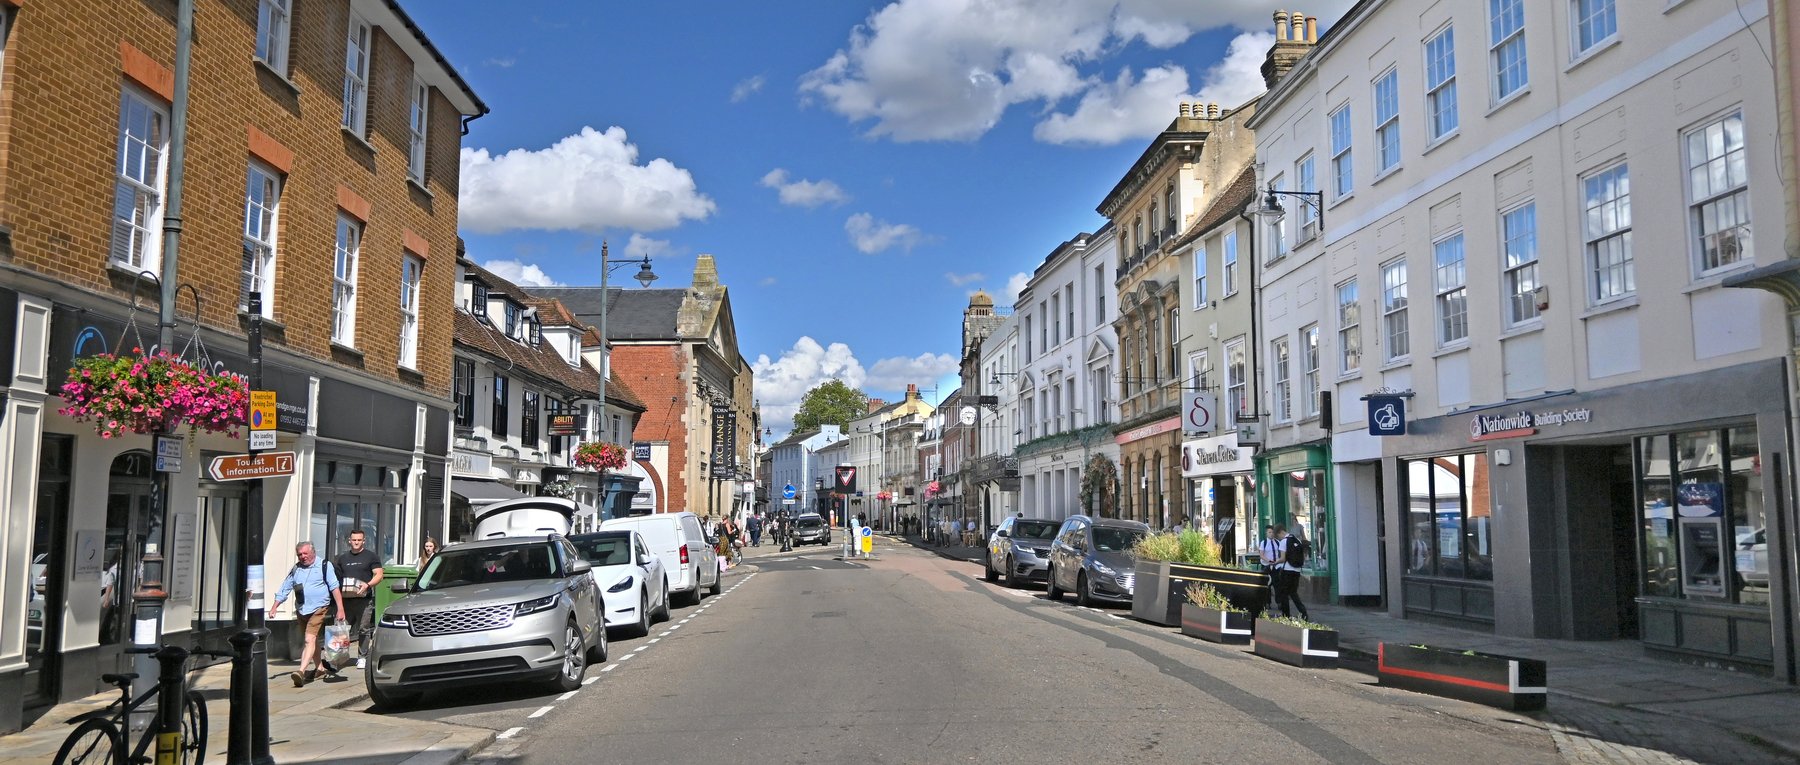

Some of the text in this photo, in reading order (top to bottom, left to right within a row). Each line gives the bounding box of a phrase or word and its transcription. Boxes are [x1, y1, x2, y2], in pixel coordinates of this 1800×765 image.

[252, 400, 265, 408] Parking
[553, 416, 574, 424] ABILITY
[1482, 408, 1591, 433] Nationwide Building Society
[716, 414, 724, 465] EXCHANGE
[125, 455, 140, 476] 21
[236, 457, 265, 467] Touist
[226, 466, 275, 476] information
